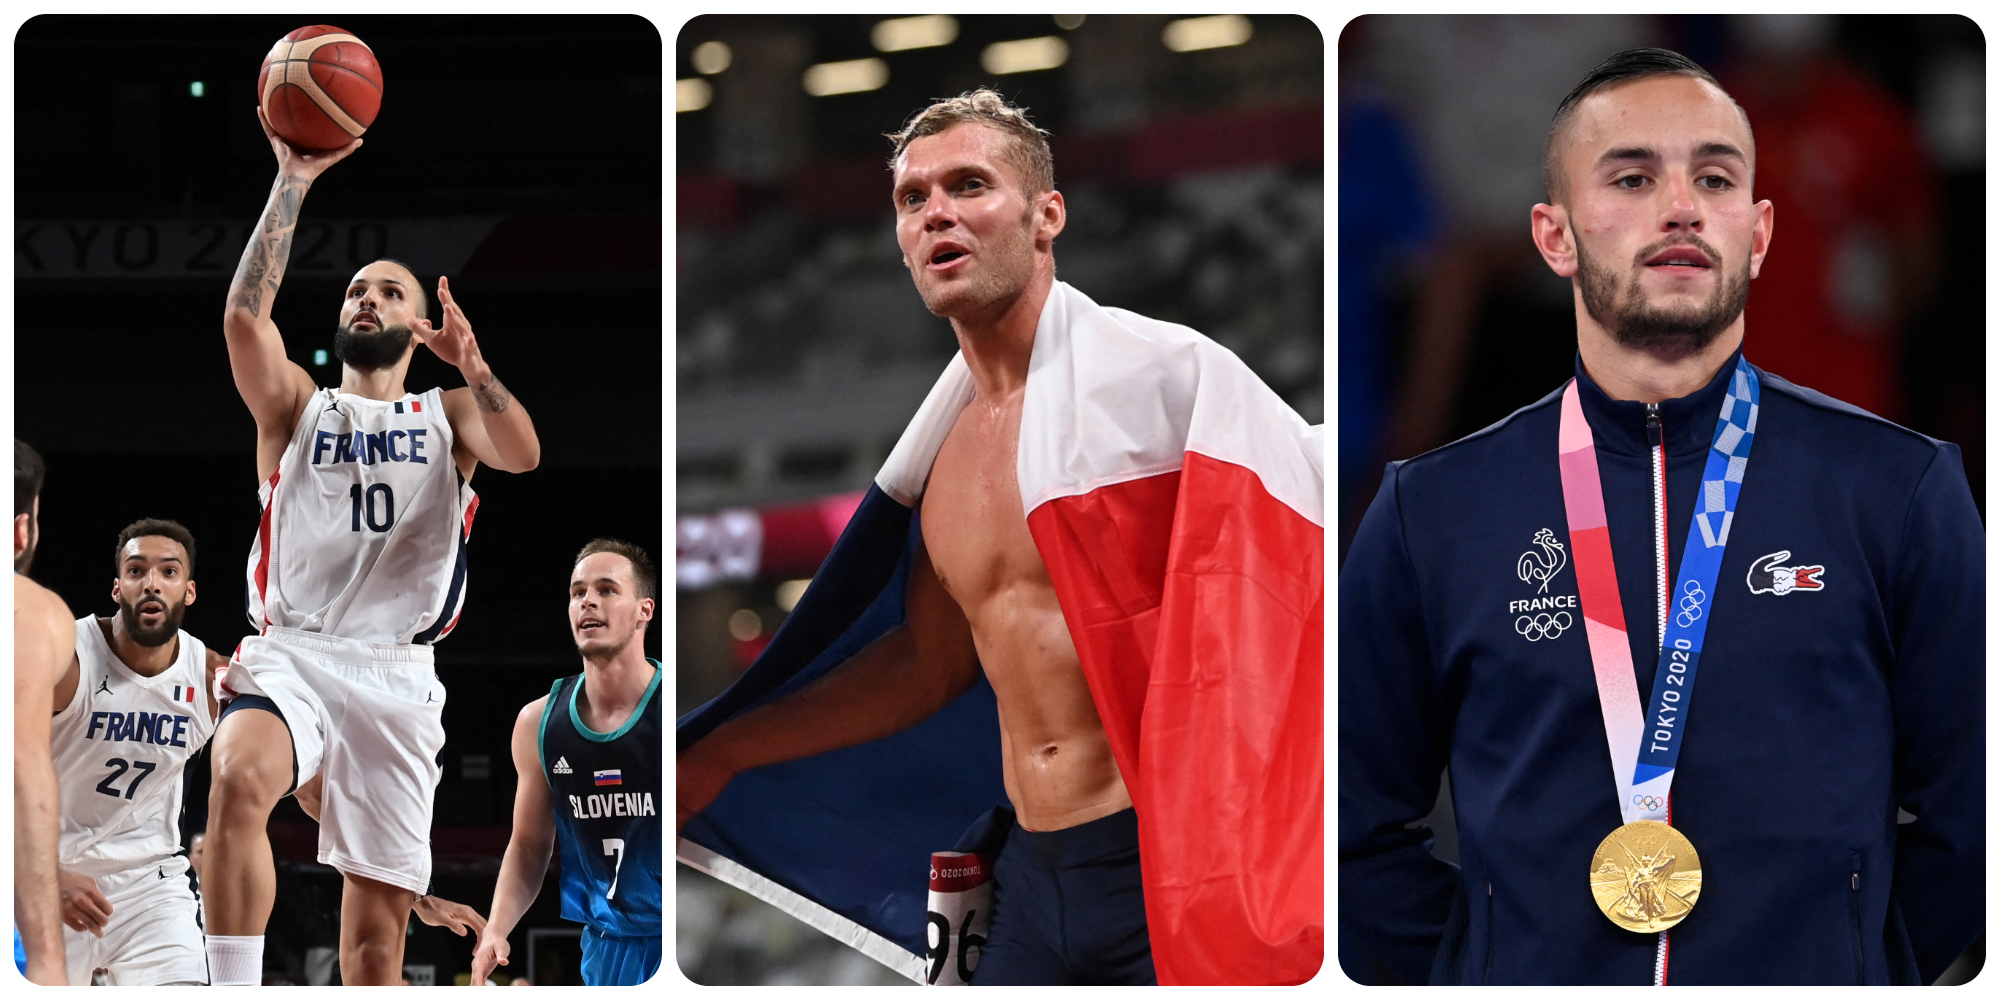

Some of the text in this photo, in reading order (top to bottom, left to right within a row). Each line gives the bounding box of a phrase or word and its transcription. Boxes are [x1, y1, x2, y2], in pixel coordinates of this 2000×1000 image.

[186, 222, 389, 271] 220
[311, 429, 429, 466] FRANCE
[349, 483, 395, 533] 10
[1509, 595, 1577, 614] FRANCE
[1650, 639, 1692, 753] TOKYO 2020
[85, 711, 191, 748] FRANCE
[95, 757, 157, 801] 27
[552, 767, 574, 775] adidas
[568, 792, 656, 819] SLOVENIA
[602, 838, 625, 900] 7
[926, 910, 986, 986] 96
